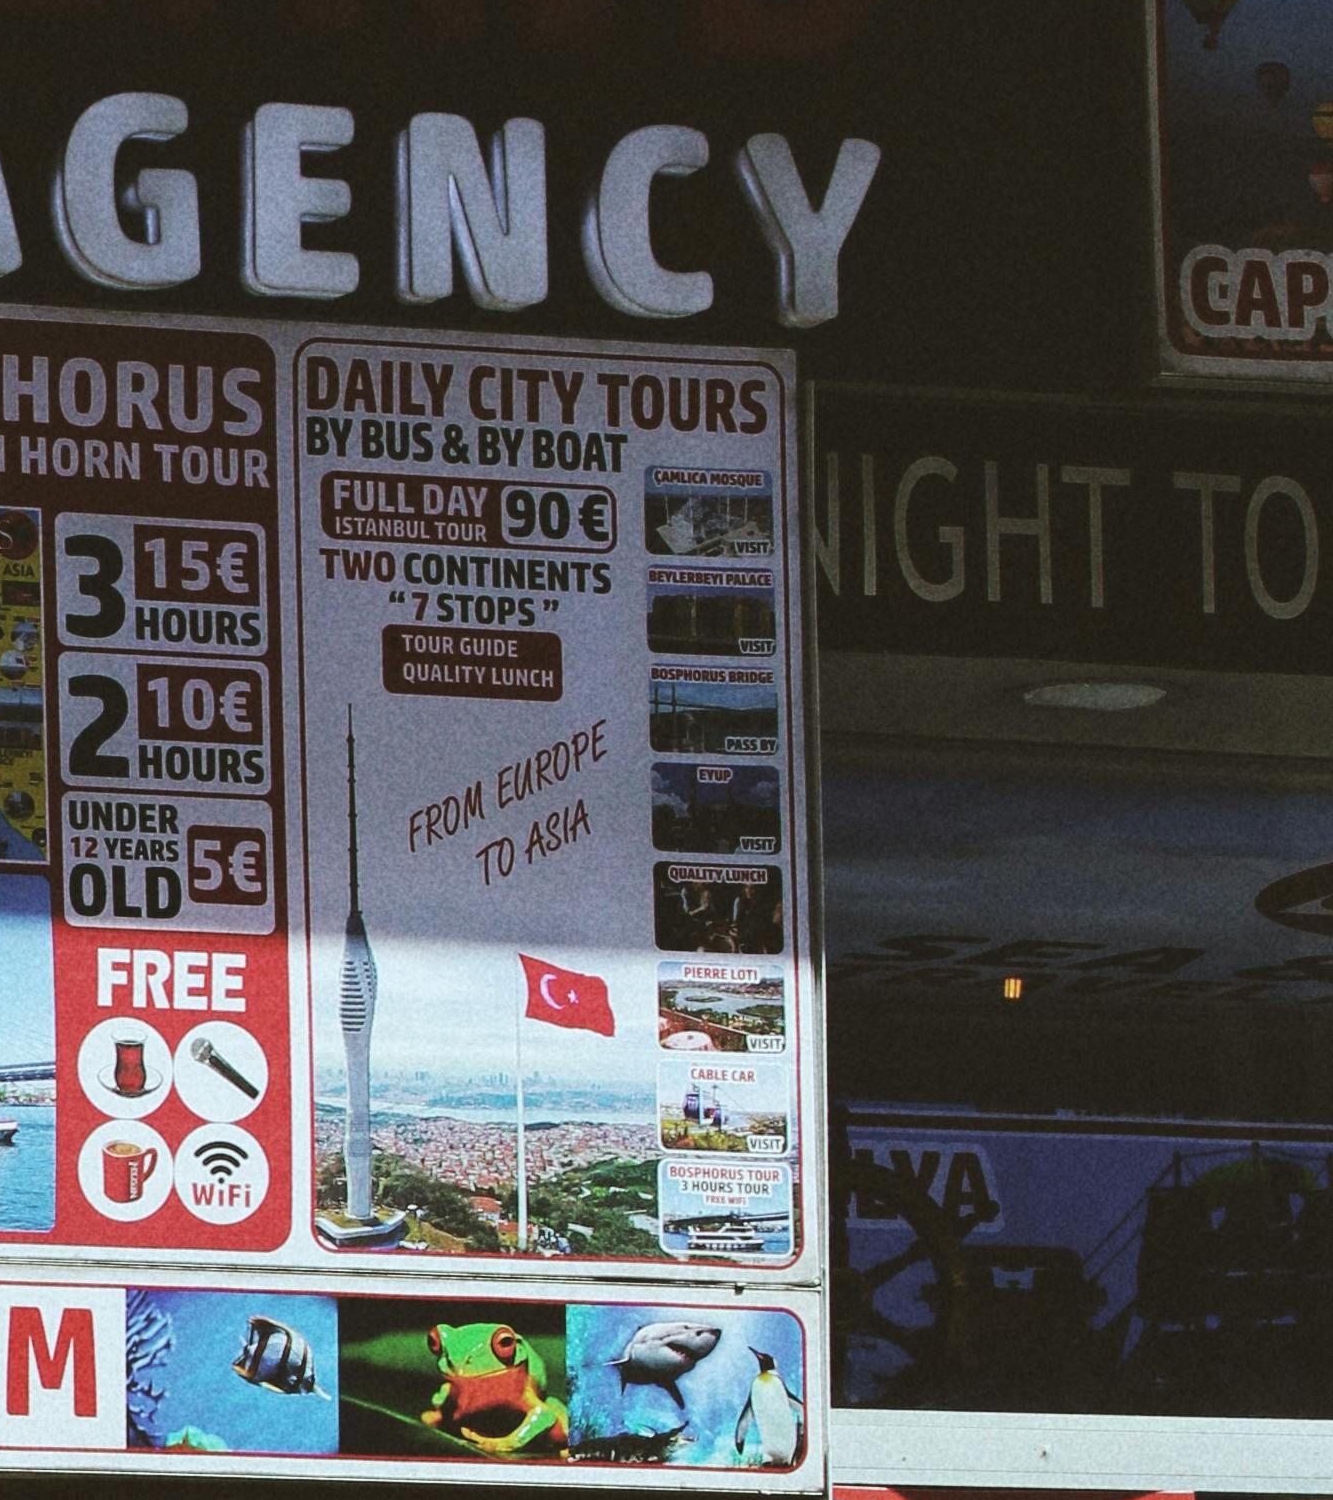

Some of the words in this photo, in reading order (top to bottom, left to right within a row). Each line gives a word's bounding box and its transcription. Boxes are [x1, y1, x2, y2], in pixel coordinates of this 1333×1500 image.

[306, 356, 454, 418] DAILY
[468, 366, 584, 425] CITY
[598, 372, 769, 435] TOURS
[361, 419, 433, 463] BUS
[478, 428, 524, 467] BY
[155, 444, 270, 489] TOUR
[710, 473, 762, 487] MOSQUE
[335, 517, 431, 539] ISTANBUL
[737, 542, 769, 553] VISIT
[144, 538, 250, 593] 15€
[403, 552, 612, 595] CONTINENTS
[64, 534, 126, 639] 3
[135, 607, 261, 647] HOURS
[741, 641, 773, 652] VISIT
[67, 674, 130, 778] 2
[147, 678, 253, 733] 10€
[408, 781, 485, 853] FROM
[498, 720, 608, 809] EUROPE
[68, 800, 180, 834] UNDER
[105, 837, 180, 863] YEARS
[476, 837, 515, 886] TO
[525, 799, 591, 864] ASIA
[741, 839, 775, 850] VISIT
[68, 863, 182, 919] OLD
[670, 868, 724, 880] QUALITY
[97, 948, 247, 1012] FREE
[750, 1039, 781, 1050] VISIT
[732, 1071, 755, 1082] CAR
[193, 1184, 251, 1208] WiFi
